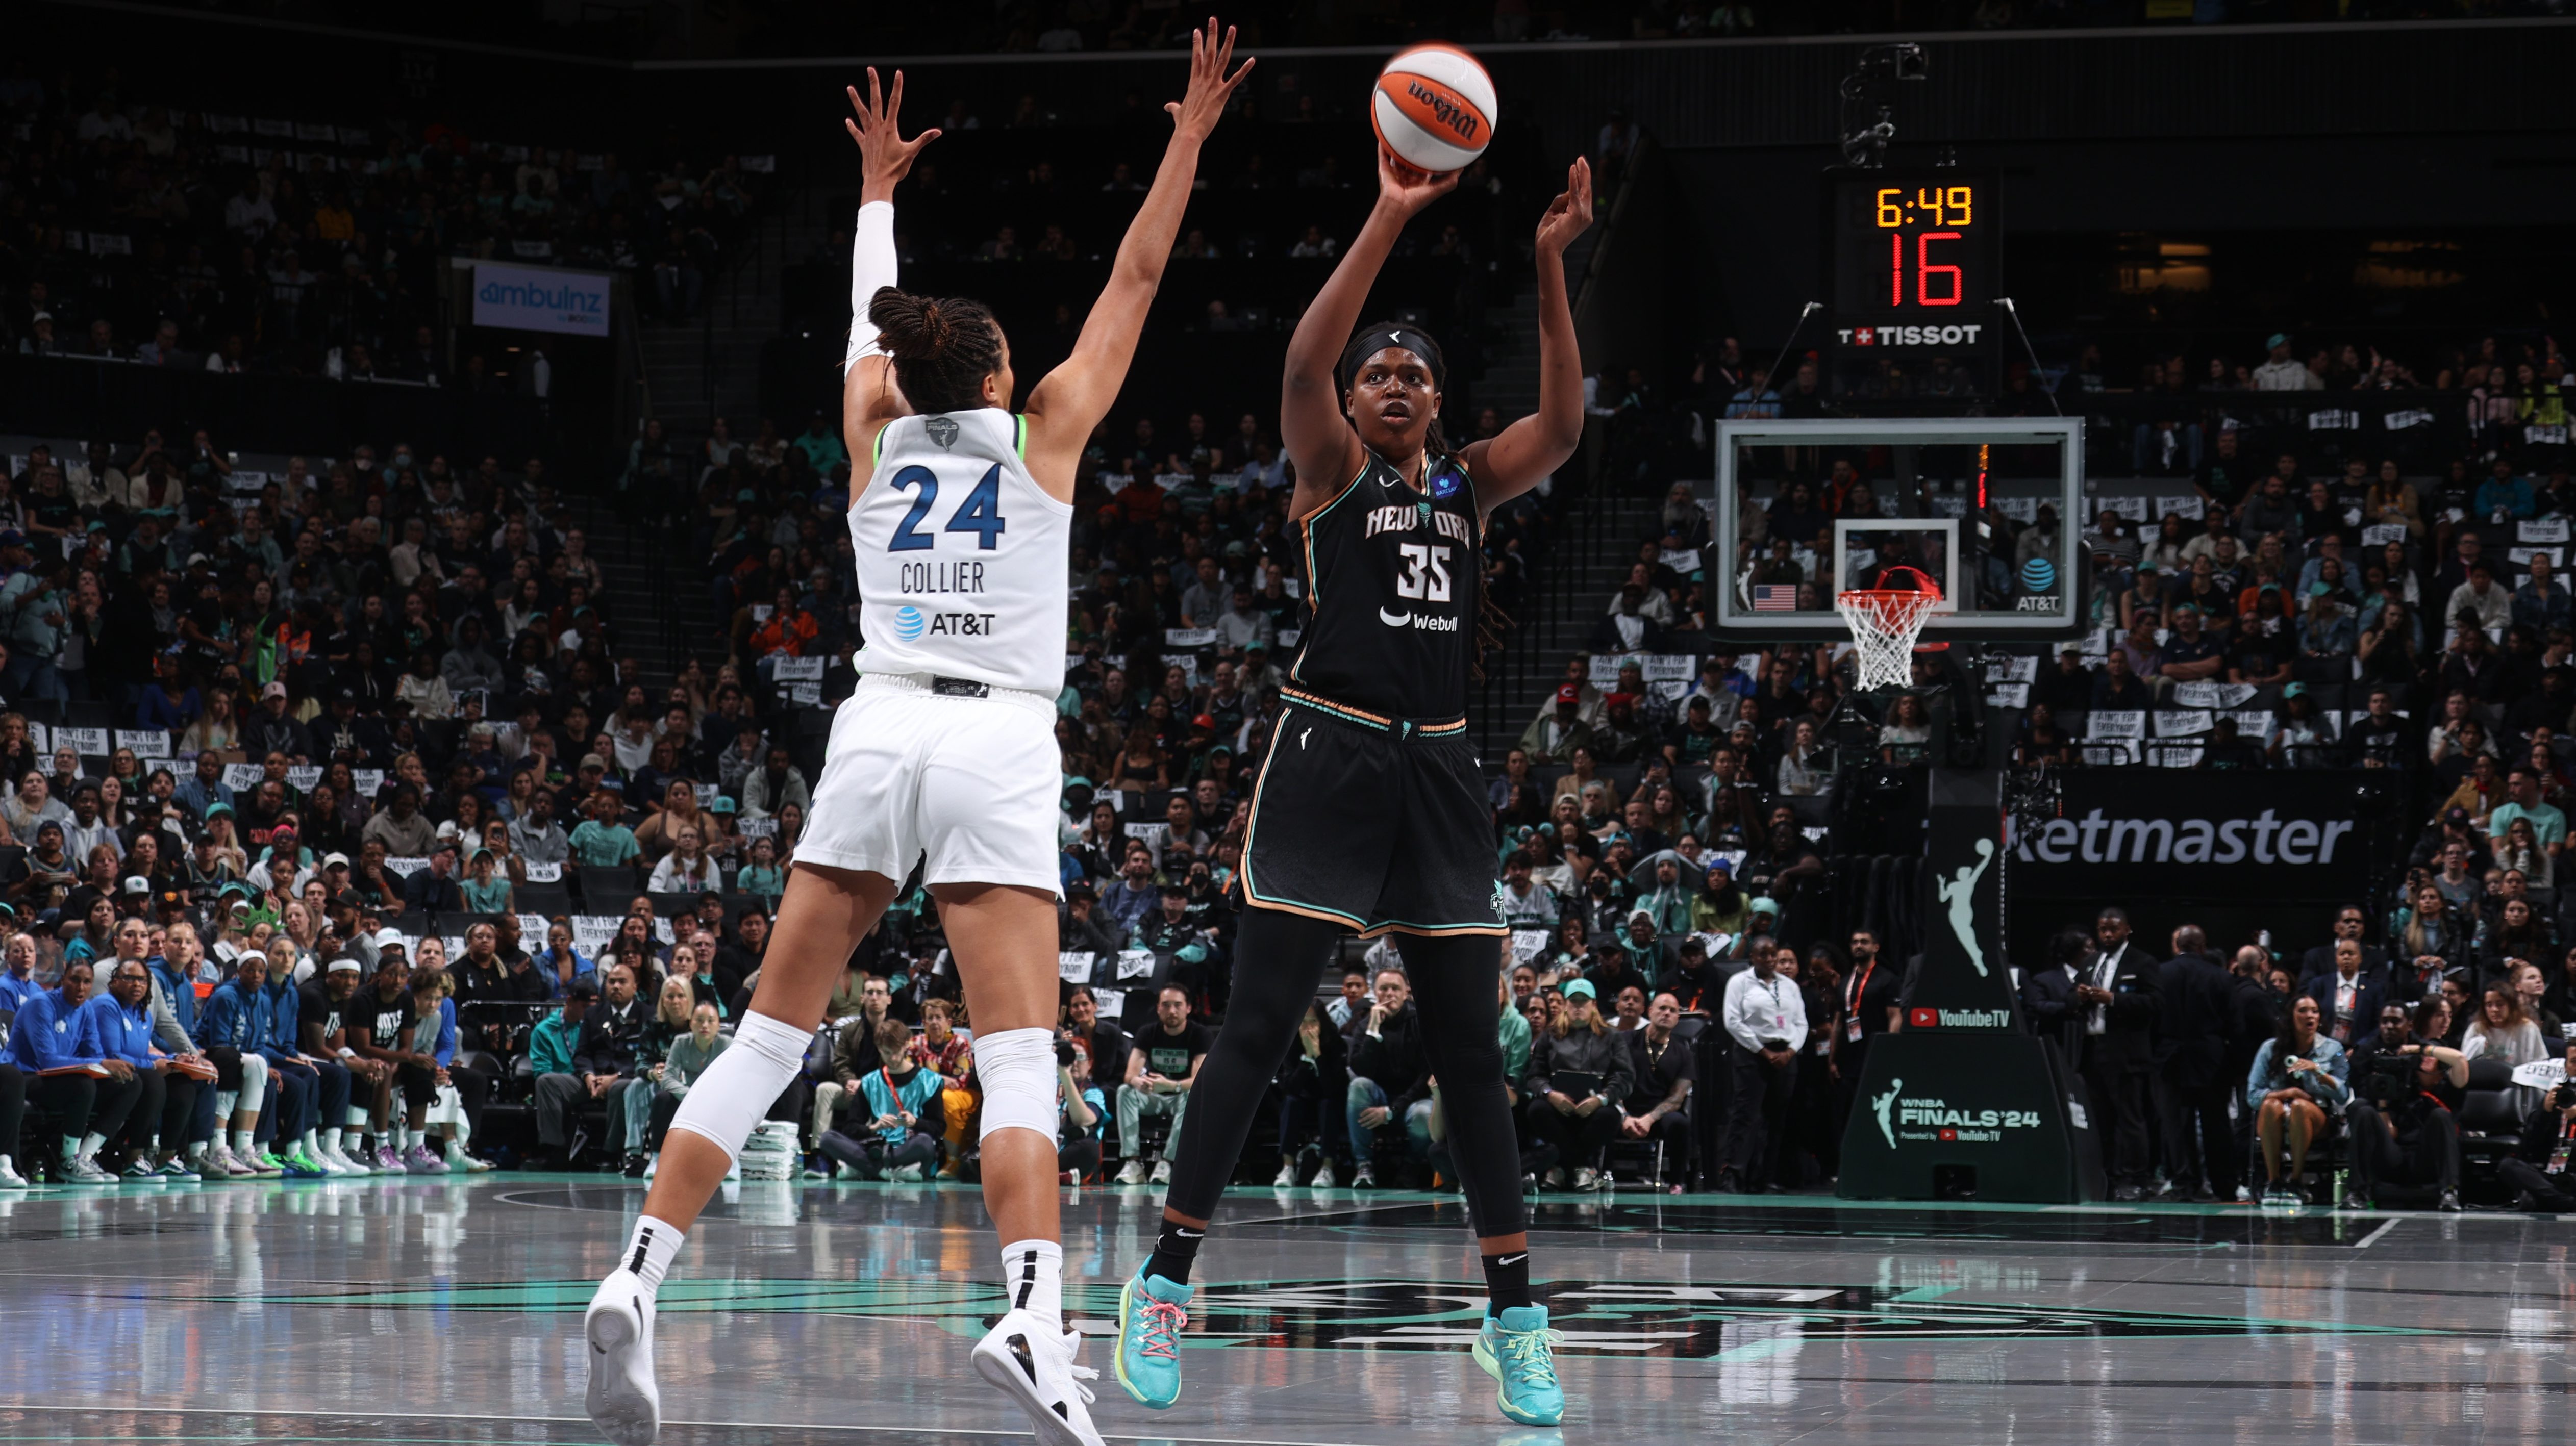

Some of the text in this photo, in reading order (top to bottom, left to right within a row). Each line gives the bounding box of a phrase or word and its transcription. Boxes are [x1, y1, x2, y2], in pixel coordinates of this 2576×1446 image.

[1408, 80, 1477, 141] Wilson
[1876, 186, 1972, 228] 6:49
[1891, 231, 1963, 307] 16
[1876, 325, 1982, 346] TISSOT
[887, 462, 1005, 552] 24
[1365, 504, 1418, 540] NEW
[901, 562, 984, 594] COLLIER
[1397, 542, 1452, 602] 35
[2016, 596, 2060, 611] AT&T
[930, 613, 995, 636] AT&T
[1413, 613, 1459, 632] Webull
[81, 729, 97, 740] FOR
[145, 731, 160, 741] FOR
[1899, 1098, 1946, 1108] WNBA
[1900, 1131, 1929, 1141] Presented
